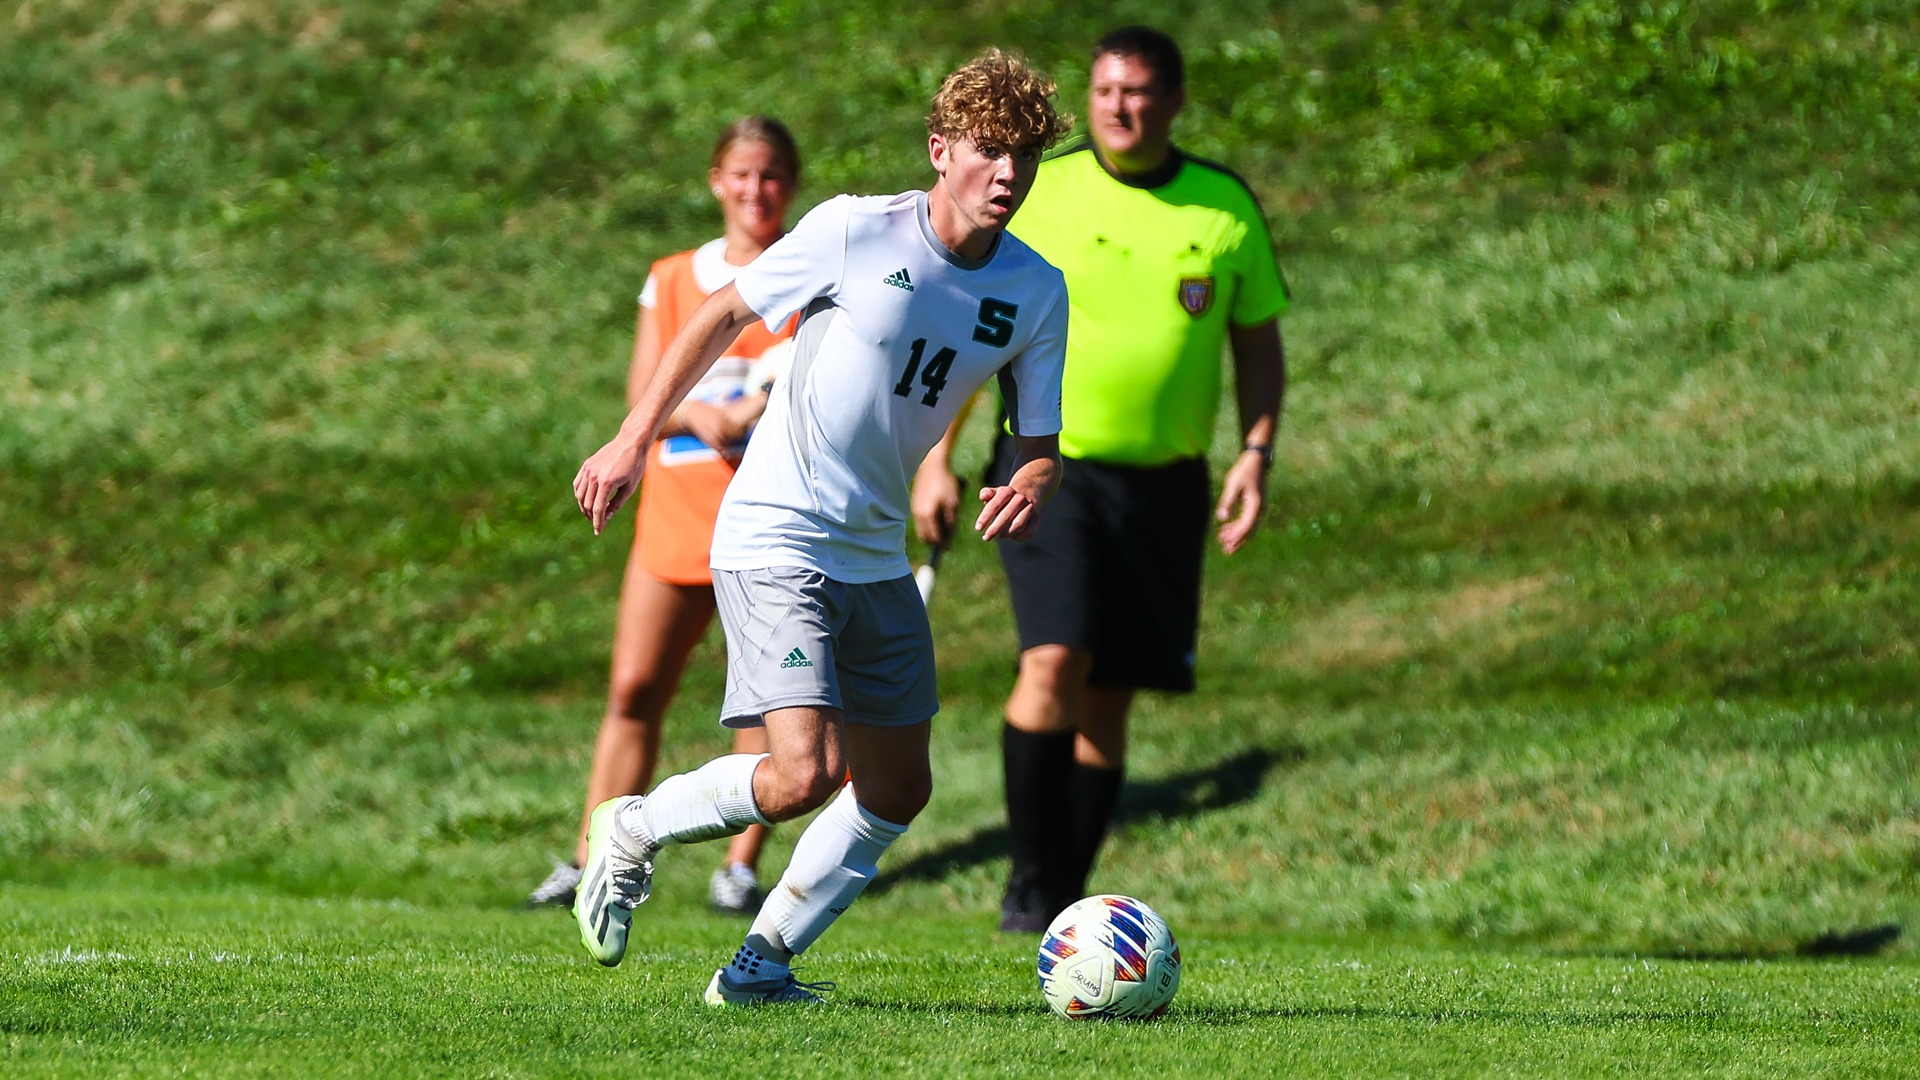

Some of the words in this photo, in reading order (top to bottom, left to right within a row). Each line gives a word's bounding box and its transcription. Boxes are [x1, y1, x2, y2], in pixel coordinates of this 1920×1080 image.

[883, 277, 915, 292] adidas
[971, 296, 1019, 349] S
[893, 337, 958, 409] 14
[780, 659, 813, 669] adidas
